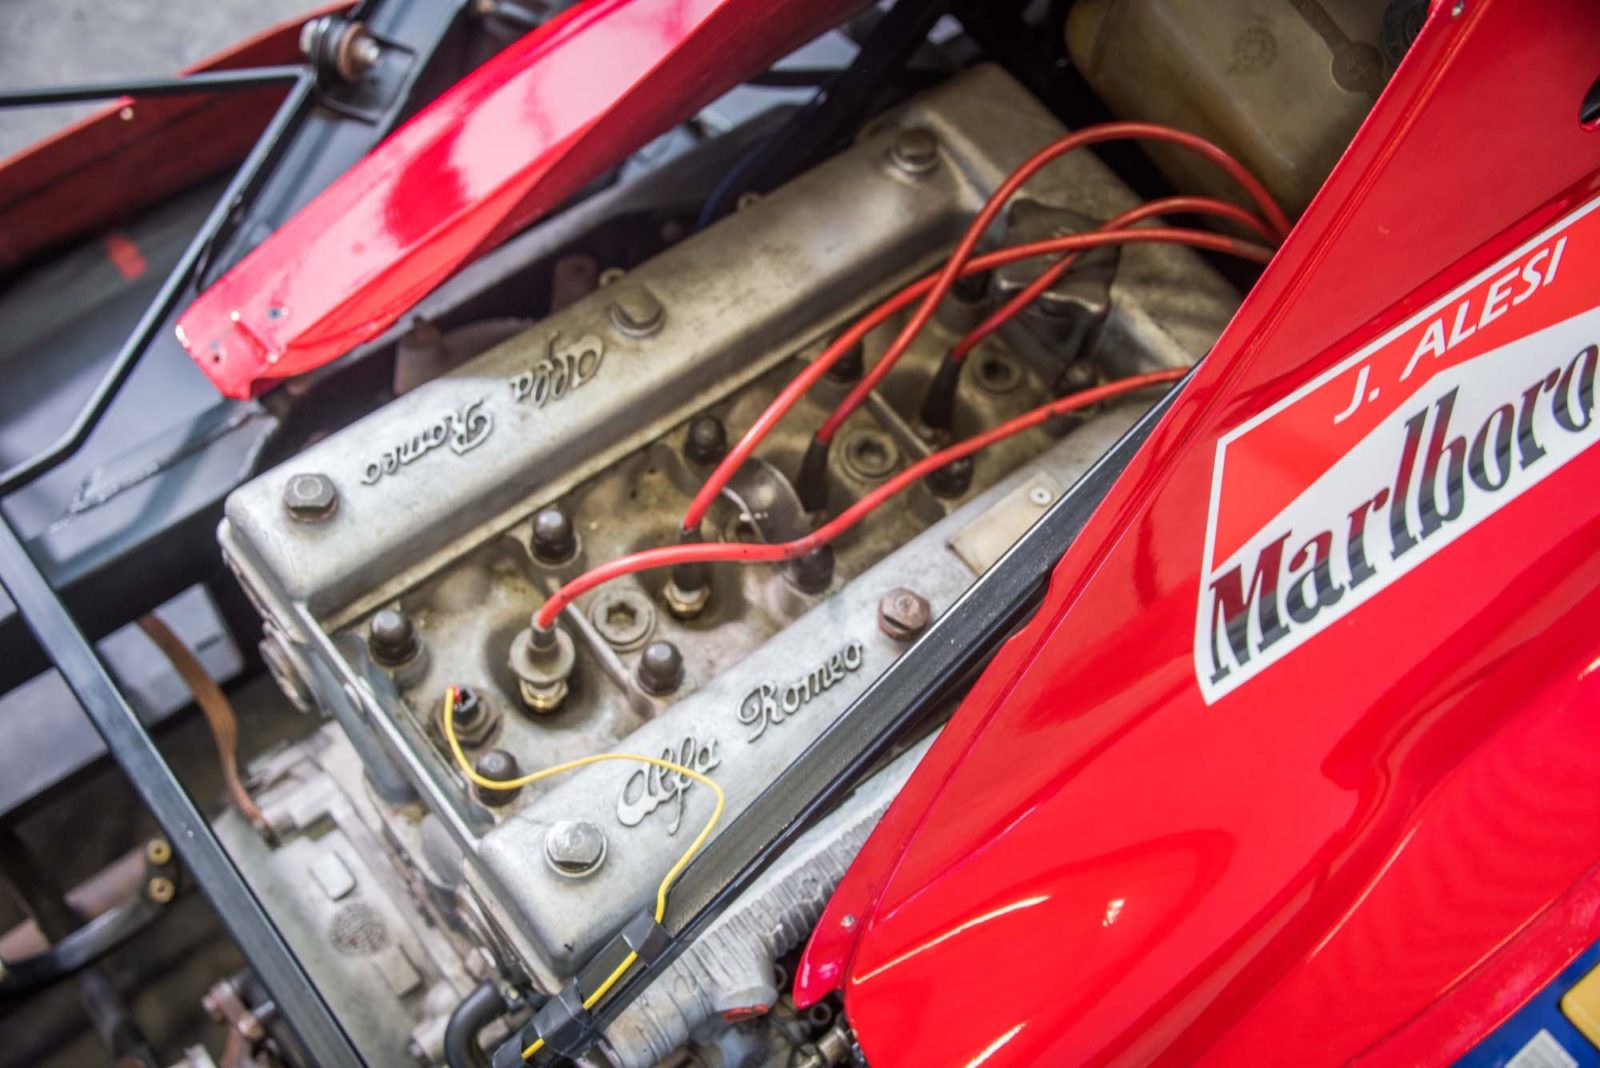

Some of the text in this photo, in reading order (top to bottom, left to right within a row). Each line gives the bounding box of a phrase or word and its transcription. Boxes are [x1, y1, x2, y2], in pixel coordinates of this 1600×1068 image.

[361, 330, 604, 485] Alfa Romeo
[1334, 236, 1567, 424] J. ALESI
[1209, 343, 1599, 686] Marlboro
[736, 641, 864, 743] Romeo
